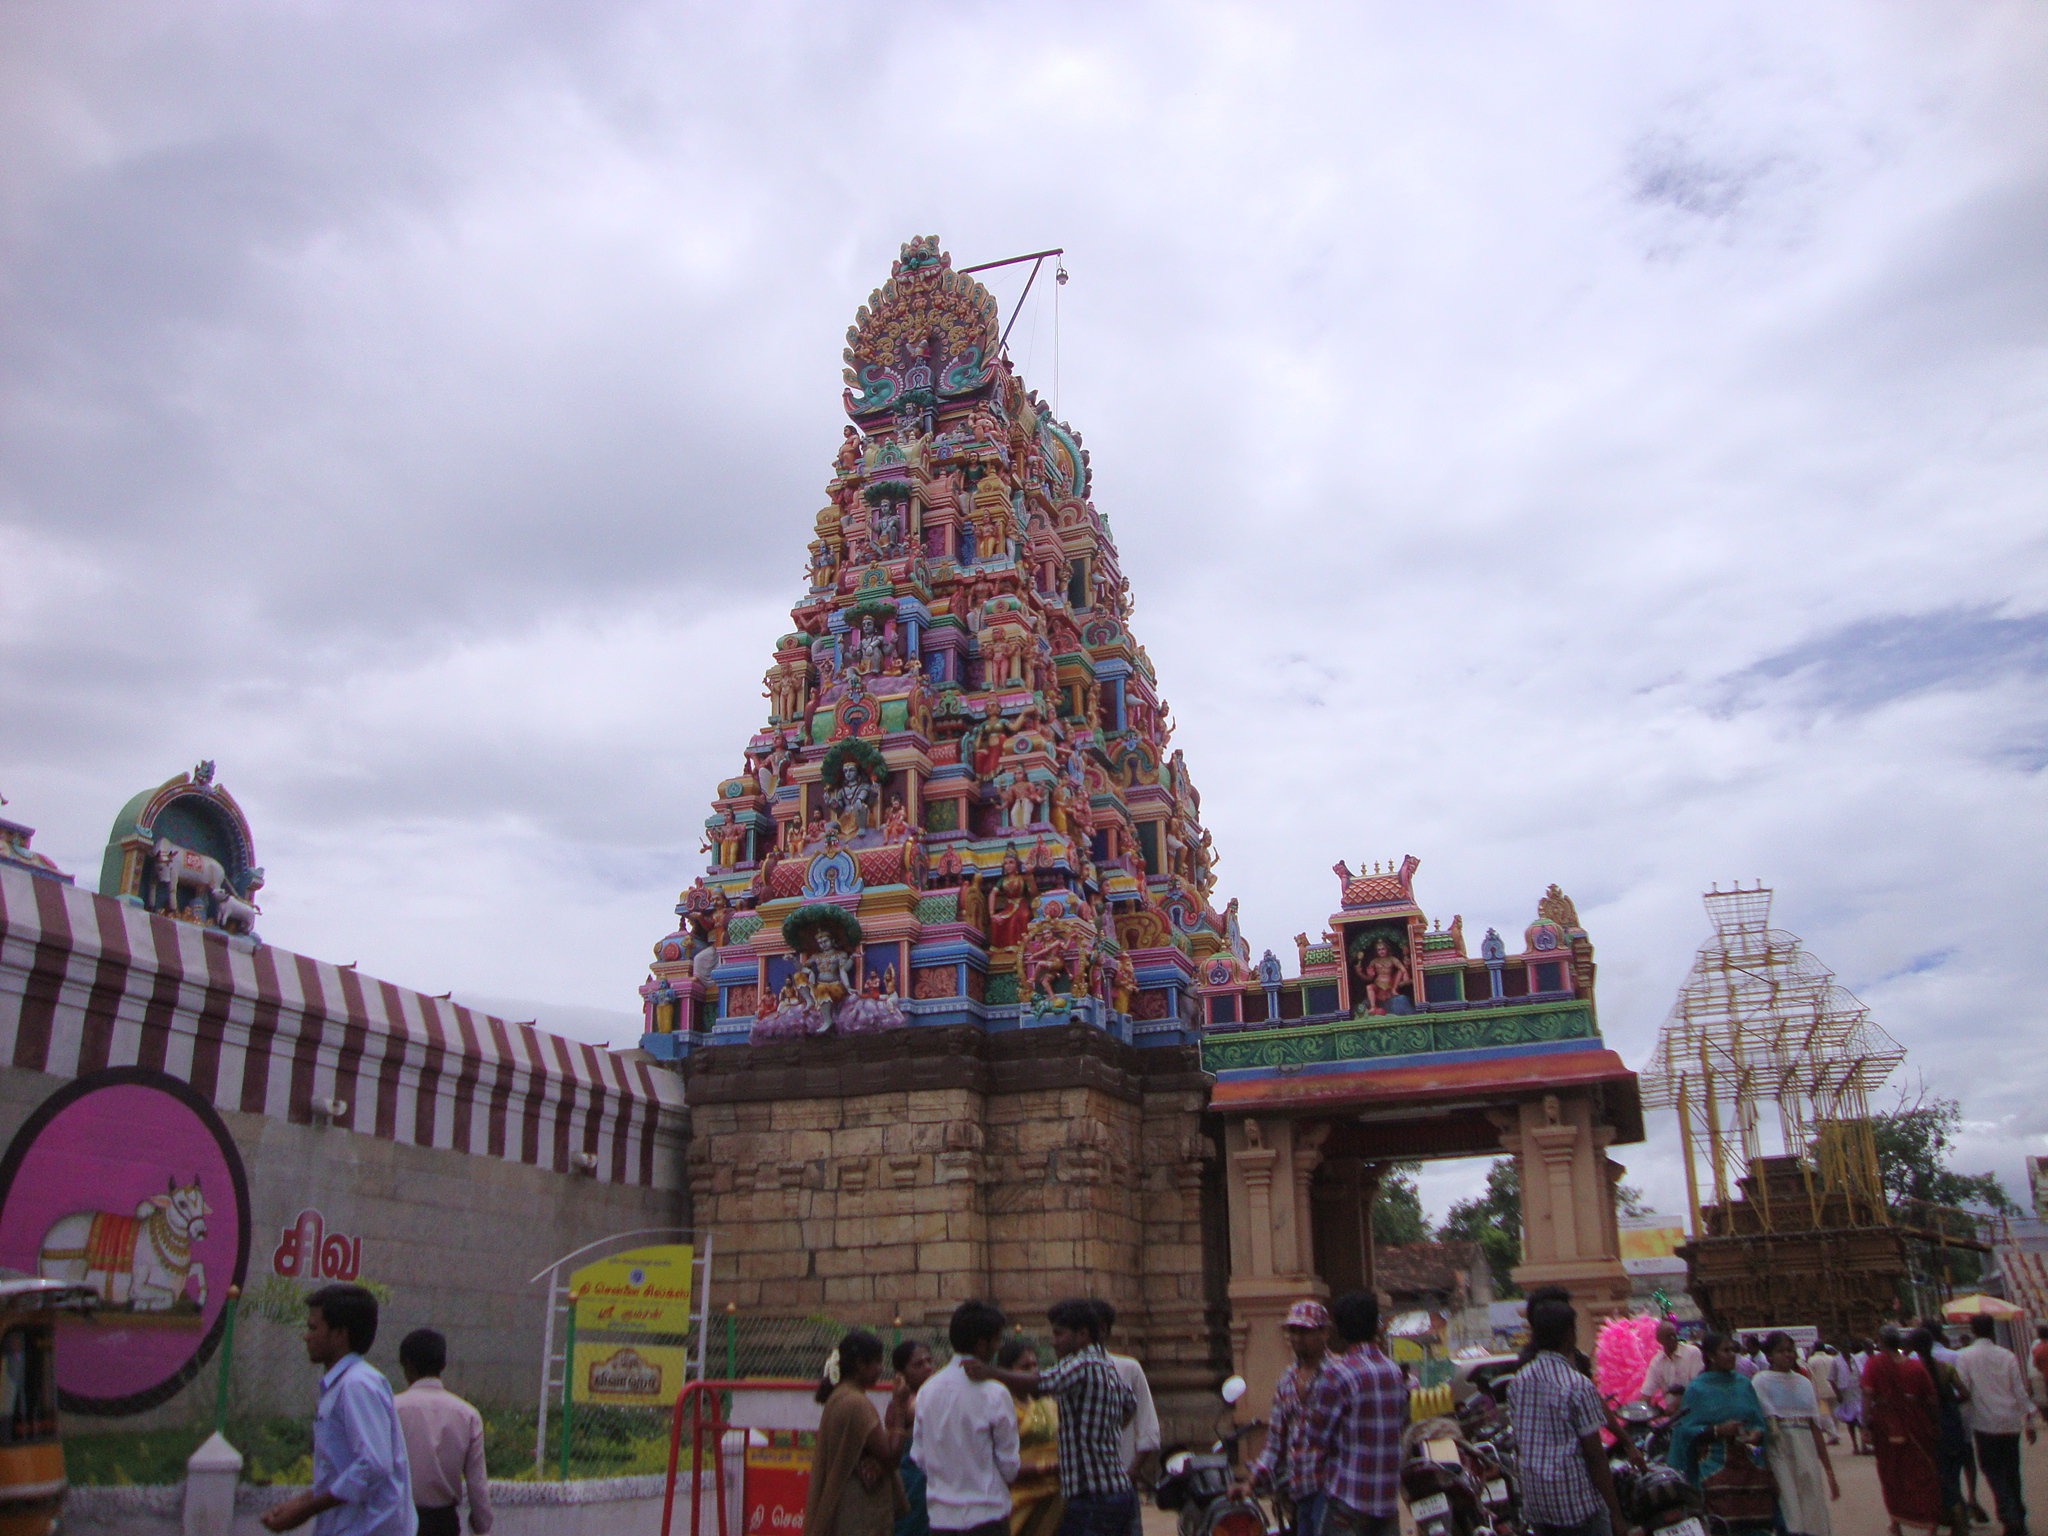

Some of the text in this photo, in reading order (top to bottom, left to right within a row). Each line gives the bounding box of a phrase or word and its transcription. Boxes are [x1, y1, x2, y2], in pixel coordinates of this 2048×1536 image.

[273, 1208, 362, 1282] சிவ
[749, 1504, 805, 1532] தி சென்
